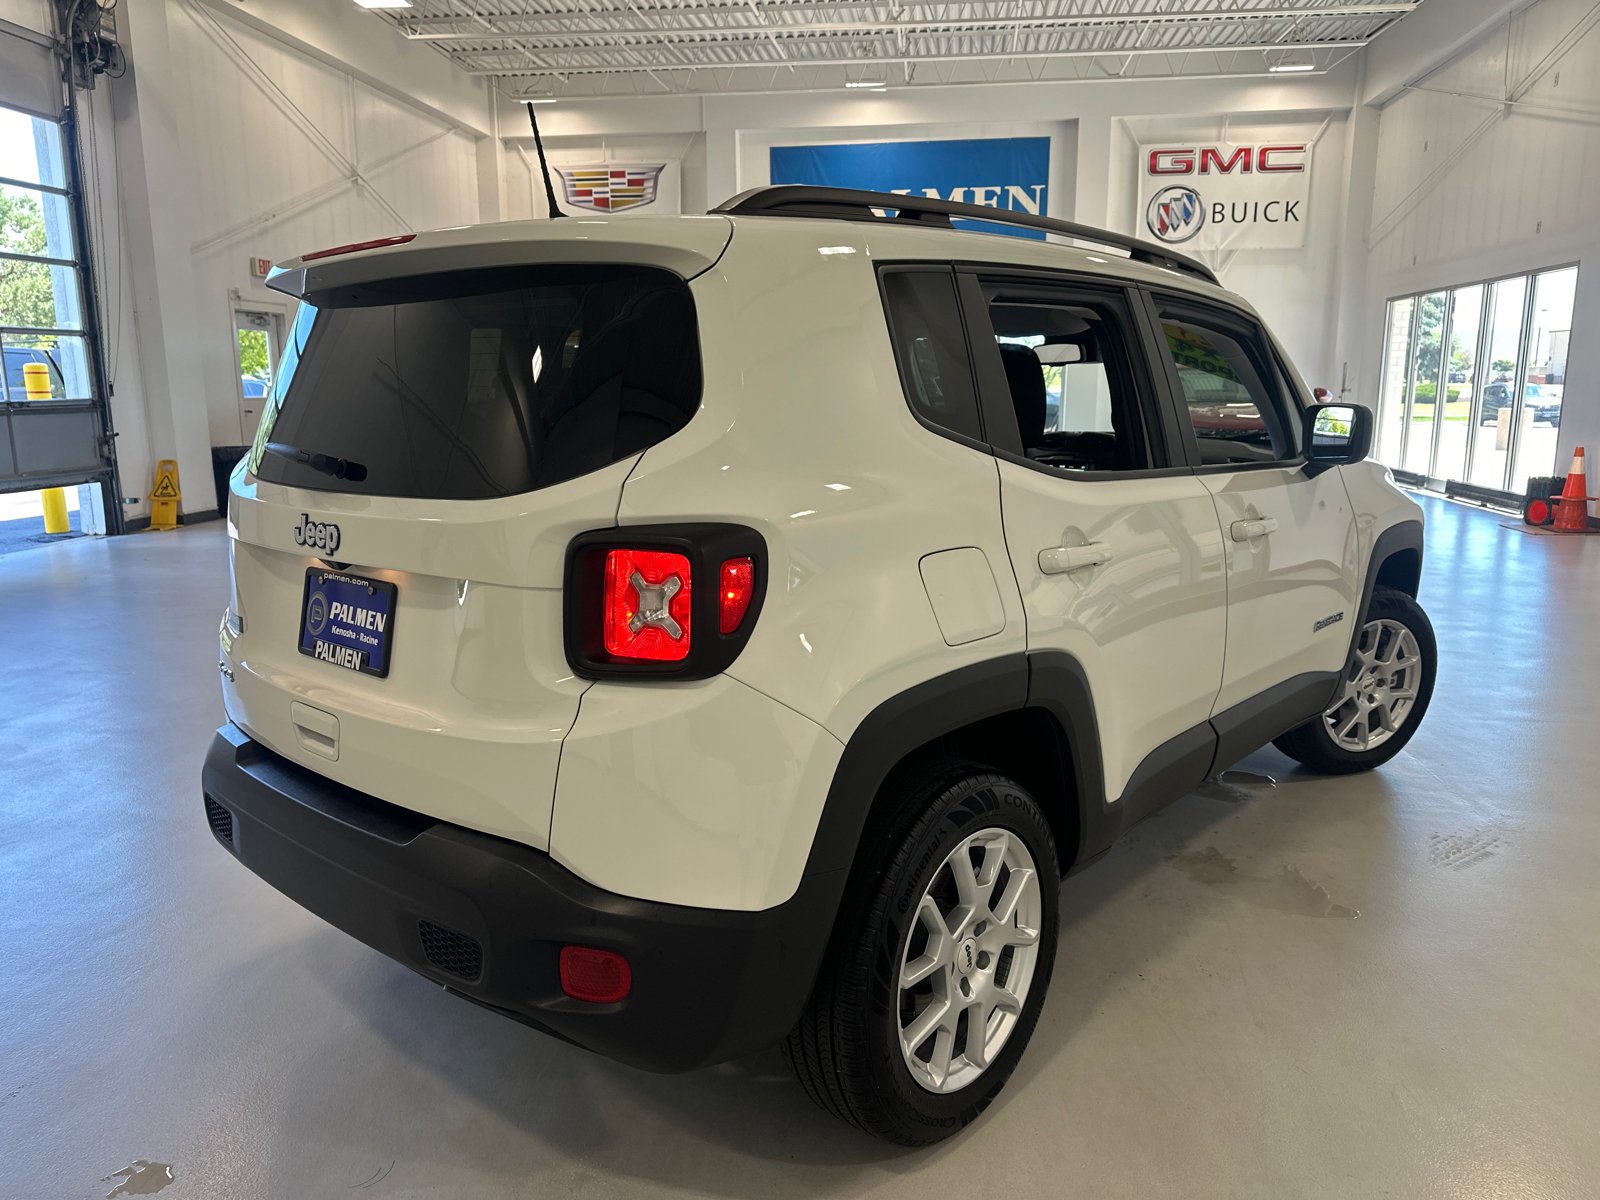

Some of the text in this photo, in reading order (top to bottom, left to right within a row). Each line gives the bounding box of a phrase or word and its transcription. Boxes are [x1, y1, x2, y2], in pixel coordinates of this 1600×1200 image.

[1147, 144, 1306, 176] GMC
[1211, 201, 1300, 223] BUICK
[294, 513, 340, 556] Jeep
[323, 572, 369, 587] palmen.com
[329, 601, 387, 632] PALMEN
[331, 625, 356, 640] Kenosha
[359, 632, 379, 646] Racine
[314, 640, 362, 671] PALMEN
